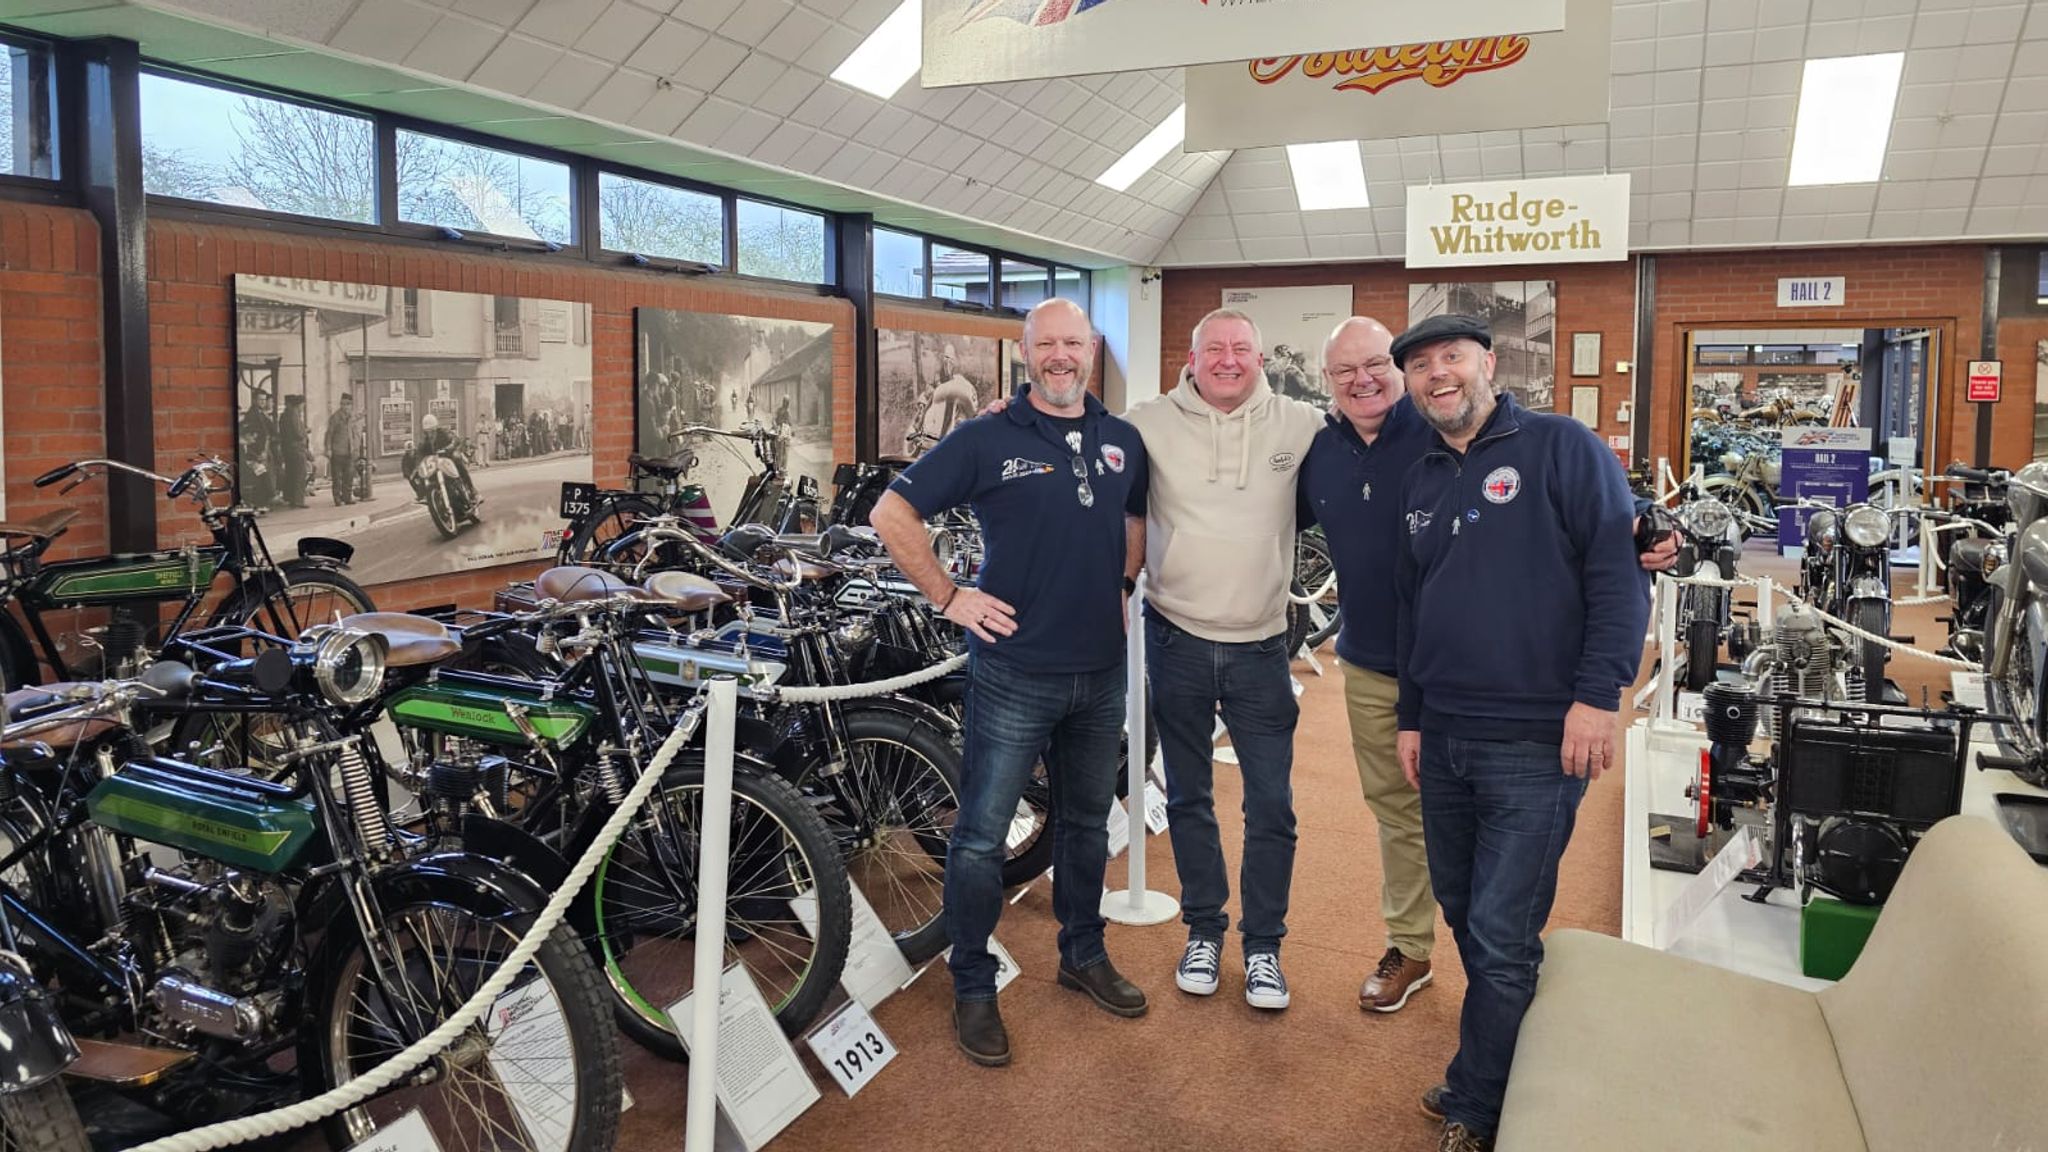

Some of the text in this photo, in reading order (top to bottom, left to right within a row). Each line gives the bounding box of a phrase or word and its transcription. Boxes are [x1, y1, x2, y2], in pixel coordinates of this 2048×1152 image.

[1451, 191, 1578, 227] Rudge-
[1430, 219, 1601, 254] Whitworth
[1791, 281, 1831, 300] HALL 2
[574, 487, 582, 500] P
[564, 501, 590, 515] 1375
[834, 1031, 884, 1081] 1913
